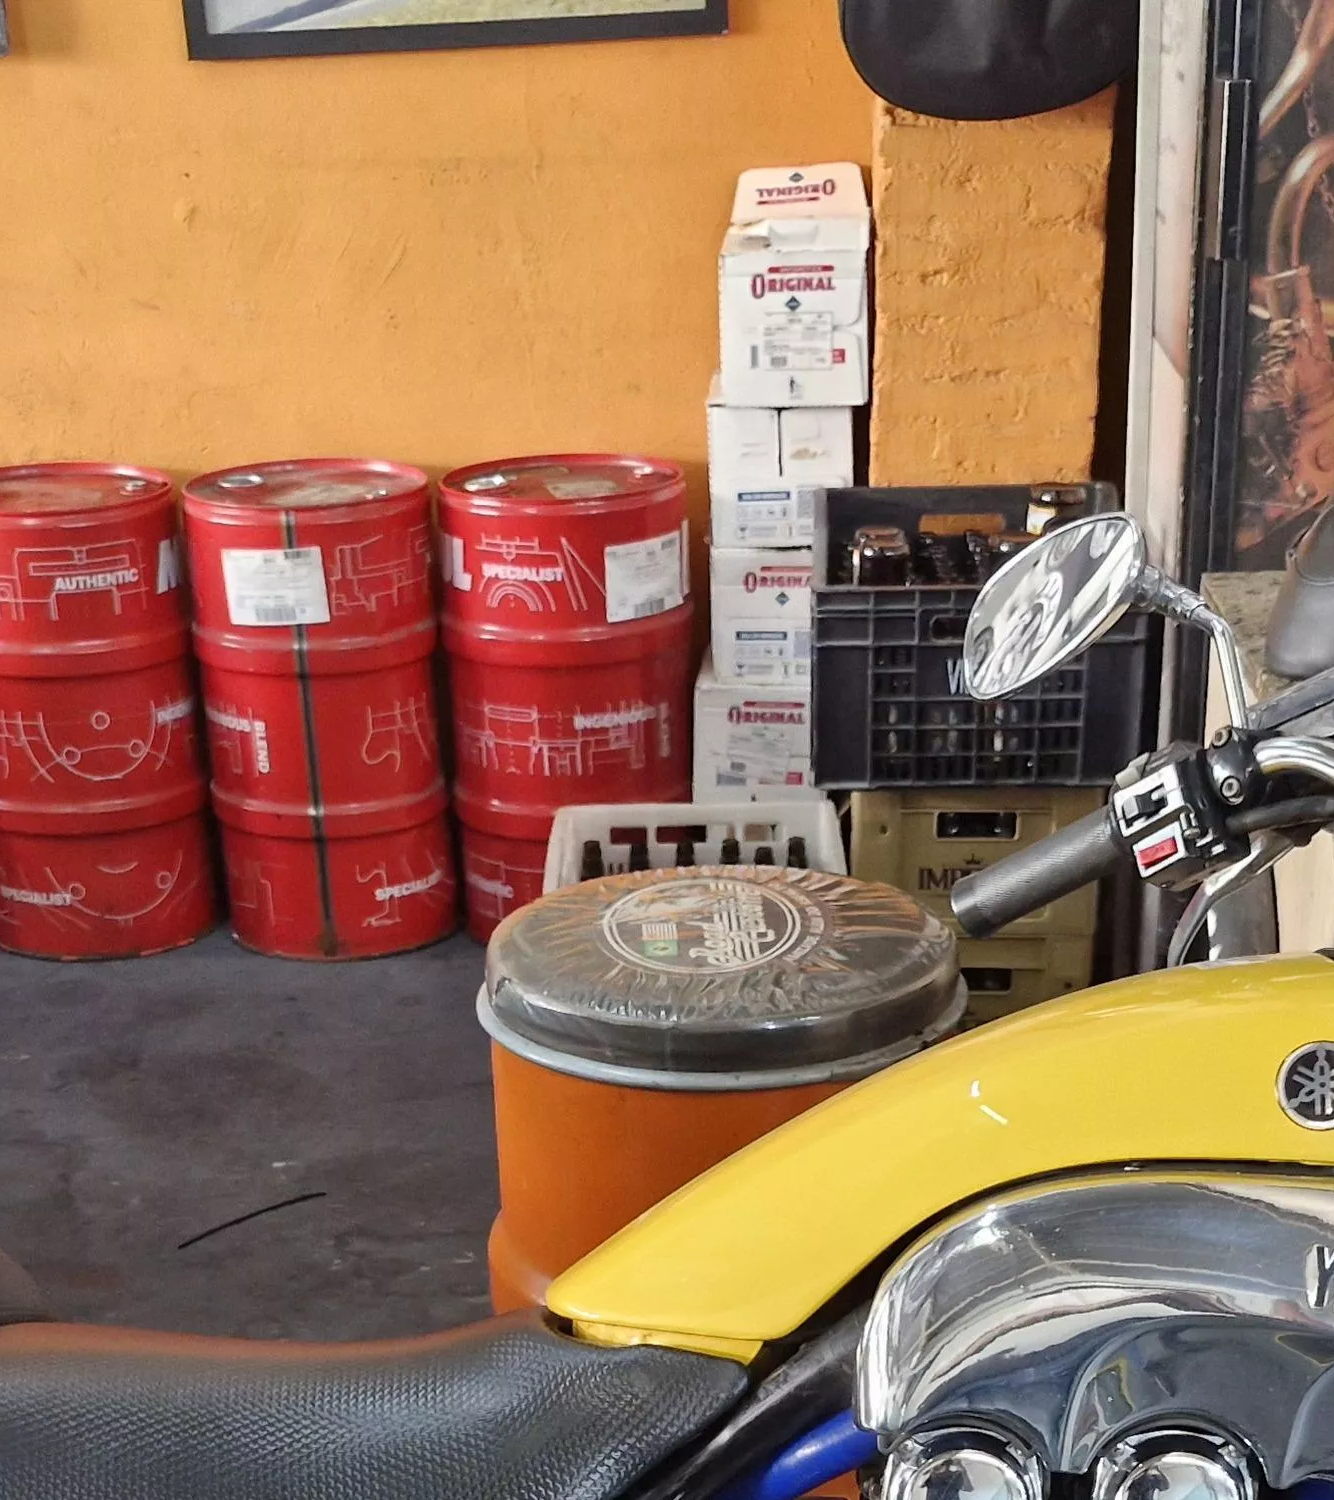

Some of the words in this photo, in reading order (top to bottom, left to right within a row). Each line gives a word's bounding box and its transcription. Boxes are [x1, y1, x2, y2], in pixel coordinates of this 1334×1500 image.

[755, 178, 837, 199] ORIGINAL
[751, 273, 836, 299] ORIGINAL
[54, 567, 140, 591] AUTHENTIC
